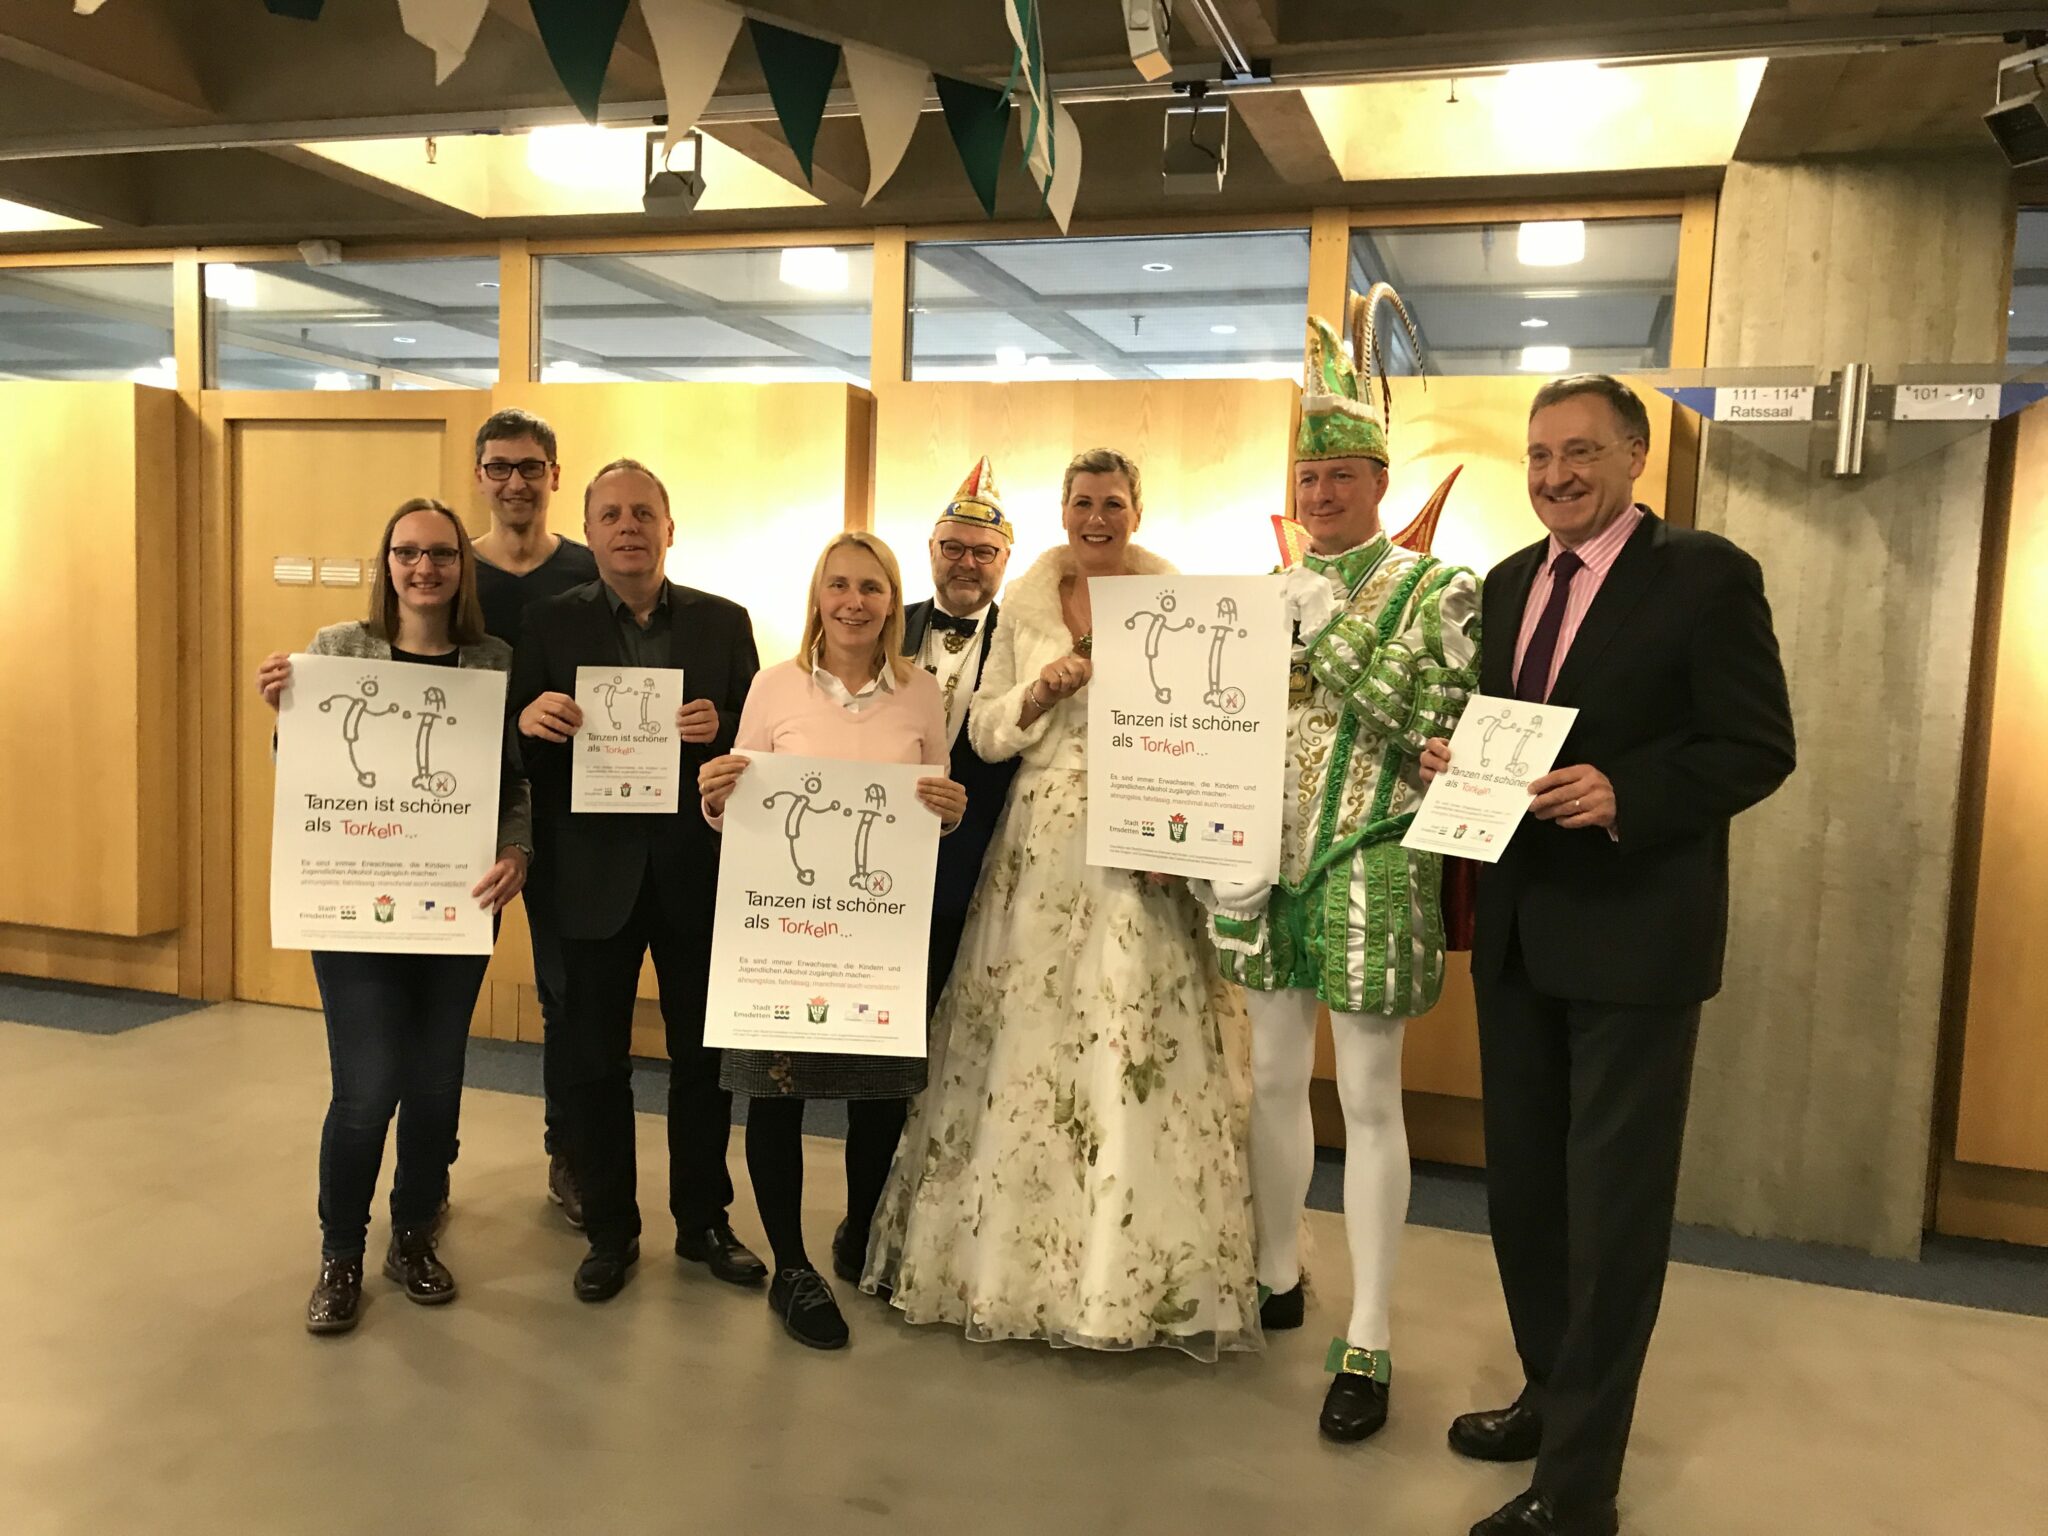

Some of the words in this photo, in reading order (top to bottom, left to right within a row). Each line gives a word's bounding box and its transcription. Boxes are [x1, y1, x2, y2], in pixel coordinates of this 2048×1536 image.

[1732, 388, 1757, 400] 111
[1774, 388, 1799, 400] 114
[1912, 387, 1938, 400] 101
[1730, 405, 1793, 418] Ratssaal
[1110, 709, 1164, 728] Tanzen
[1169, 712, 1188, 729] ist
[1191, 714, 1260, 733] schöner
[587, 732, 618, 742] Tanzen
[620, 733, 631, 742] ist
[1111, 732, 1133, 748] als
[586, 744, 601, 753] als
[1451, 766, 1481, 779] Tanzen
[1445, 779, 1459, 788] als
[304, 794, 369, 811] Tanzen
[373, 796, 394, 812] ist
[400, 797, 473, 815] schöner
[305, 817, 332, 832] als
[745, 890, 806, 909] Tanzen
[811, 894, 832, 910] ist
[836, 897, 906, 915] schöner
[744, 914, 770, 930] als
